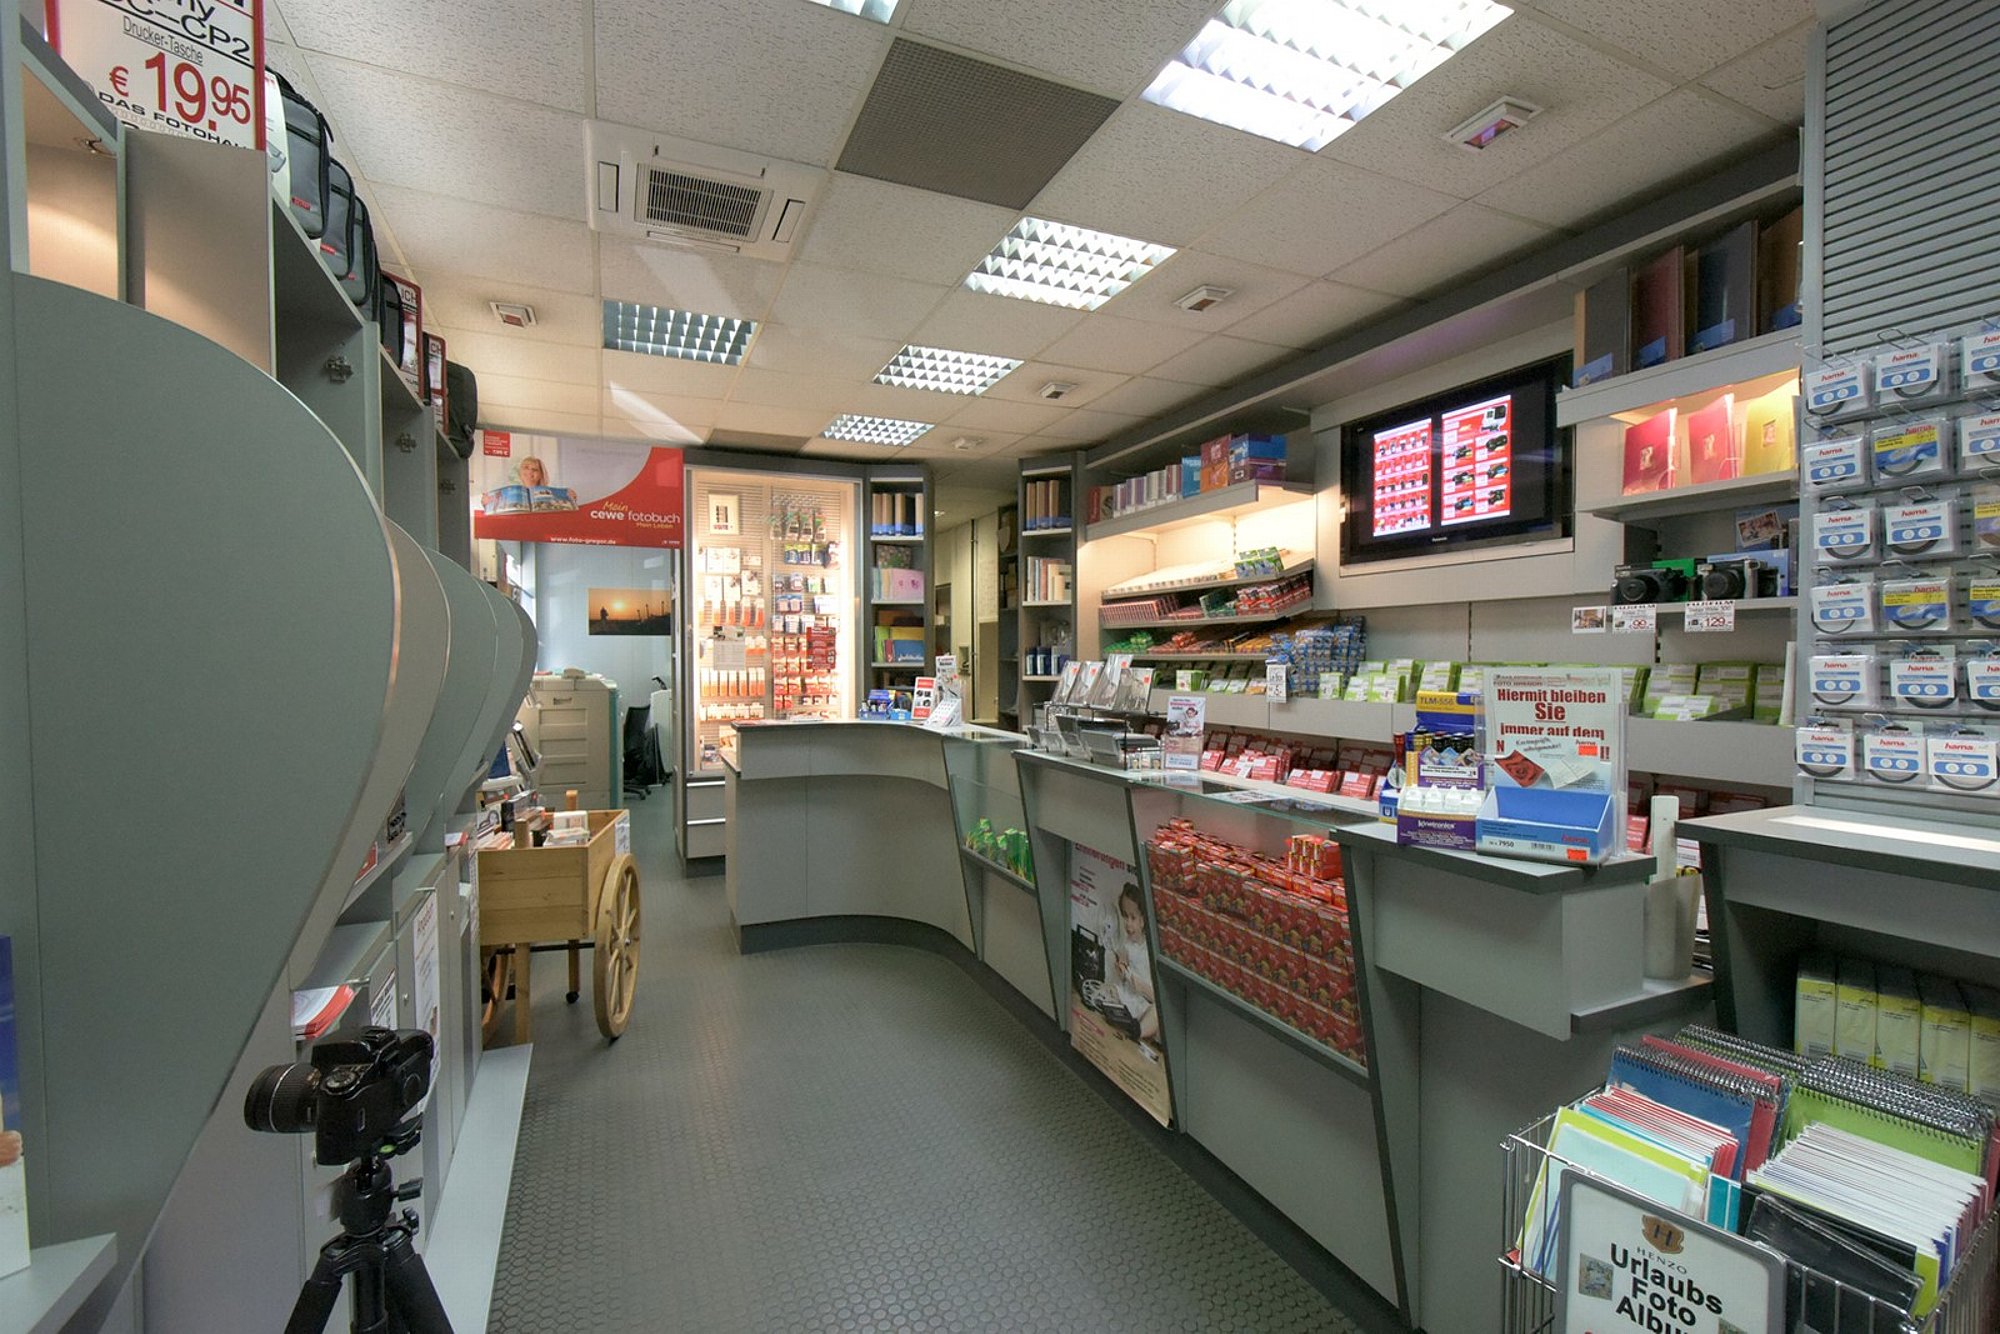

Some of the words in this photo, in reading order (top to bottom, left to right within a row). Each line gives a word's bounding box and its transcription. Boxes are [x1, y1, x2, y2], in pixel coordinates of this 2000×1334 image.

[123, 15, 204, 64] Drucker-Tasche
[109, 65, 129, 97] €
[98, 91, 146, 117] DAS
[154, 111, 248, 149] FOTOHA
[1892, 352, 1919, 363] hama
[1821, 369, 1846, 382] hama
[1819, 447, 1843, 456] hama
[603, 501, 628, 511] Mein
[590, 510, 624, 520] cewe
[628, 511, 681, 524] fotobuch
[1901, 508, 1928, 517] hama
[1828, 514, 1852, 524] hama
[1826, 589, 1850, 598] hama
[1914, 584, 1941, 593] hama
[1824, 661, 1847, 669] hama
[1907, 664, 1935, 672] hama
[1497, 689, 1547, 702] Hiermit
[1551, 690, 1606, 703] bleiben
[1535, 702, 1566, 721] Sie
[1547, 726, 1571, 737] auf
[1573, 726, 1605, 741] dem
[1811, 734, 1835, 742] hama
[1879, 739, 1905, 747] hama
[1945, 742, 1974, 751] hama
[1653, 1224, 1673, 1247] H
[1636, 1246, 1687, 1275] HENZO
[1610, 1242, 1723, 1316] Urlaubs
[1632, 1277, 1697, 1327] Foto
